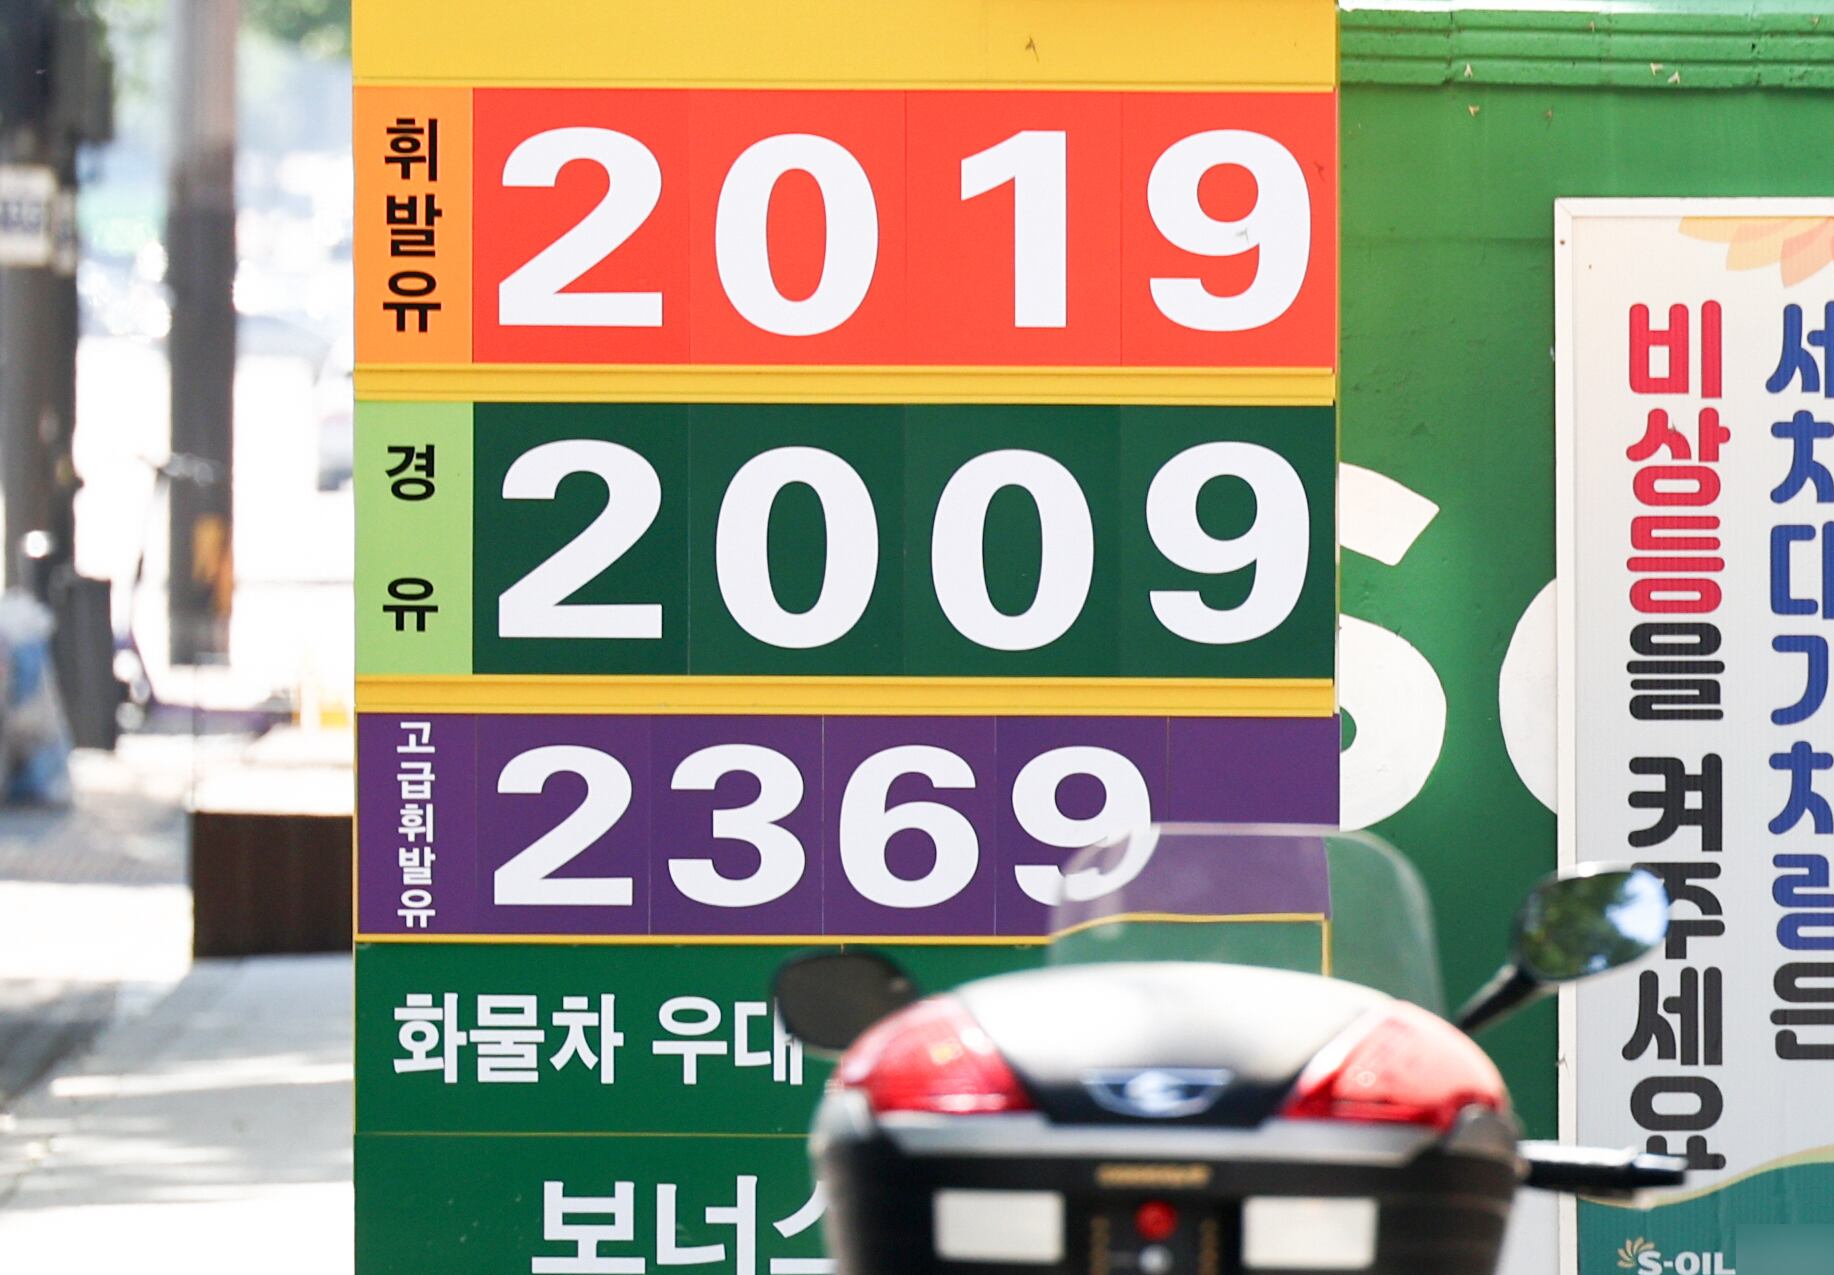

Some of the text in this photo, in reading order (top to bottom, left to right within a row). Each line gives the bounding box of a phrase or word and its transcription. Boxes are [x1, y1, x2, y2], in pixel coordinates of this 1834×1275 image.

[383, 118, 441, 333] 휘발유
[498, 126, 1312, 336] 2019
[498, 438, 1311, 651] 2009
[397, 720, 436, 928] 고급휘발유
[494, 744, 1161, 908] 2369
[1621, 299, 1731, 1171] 비상등을 켜주세요
[394, 992, 624, 1085] 화물차
